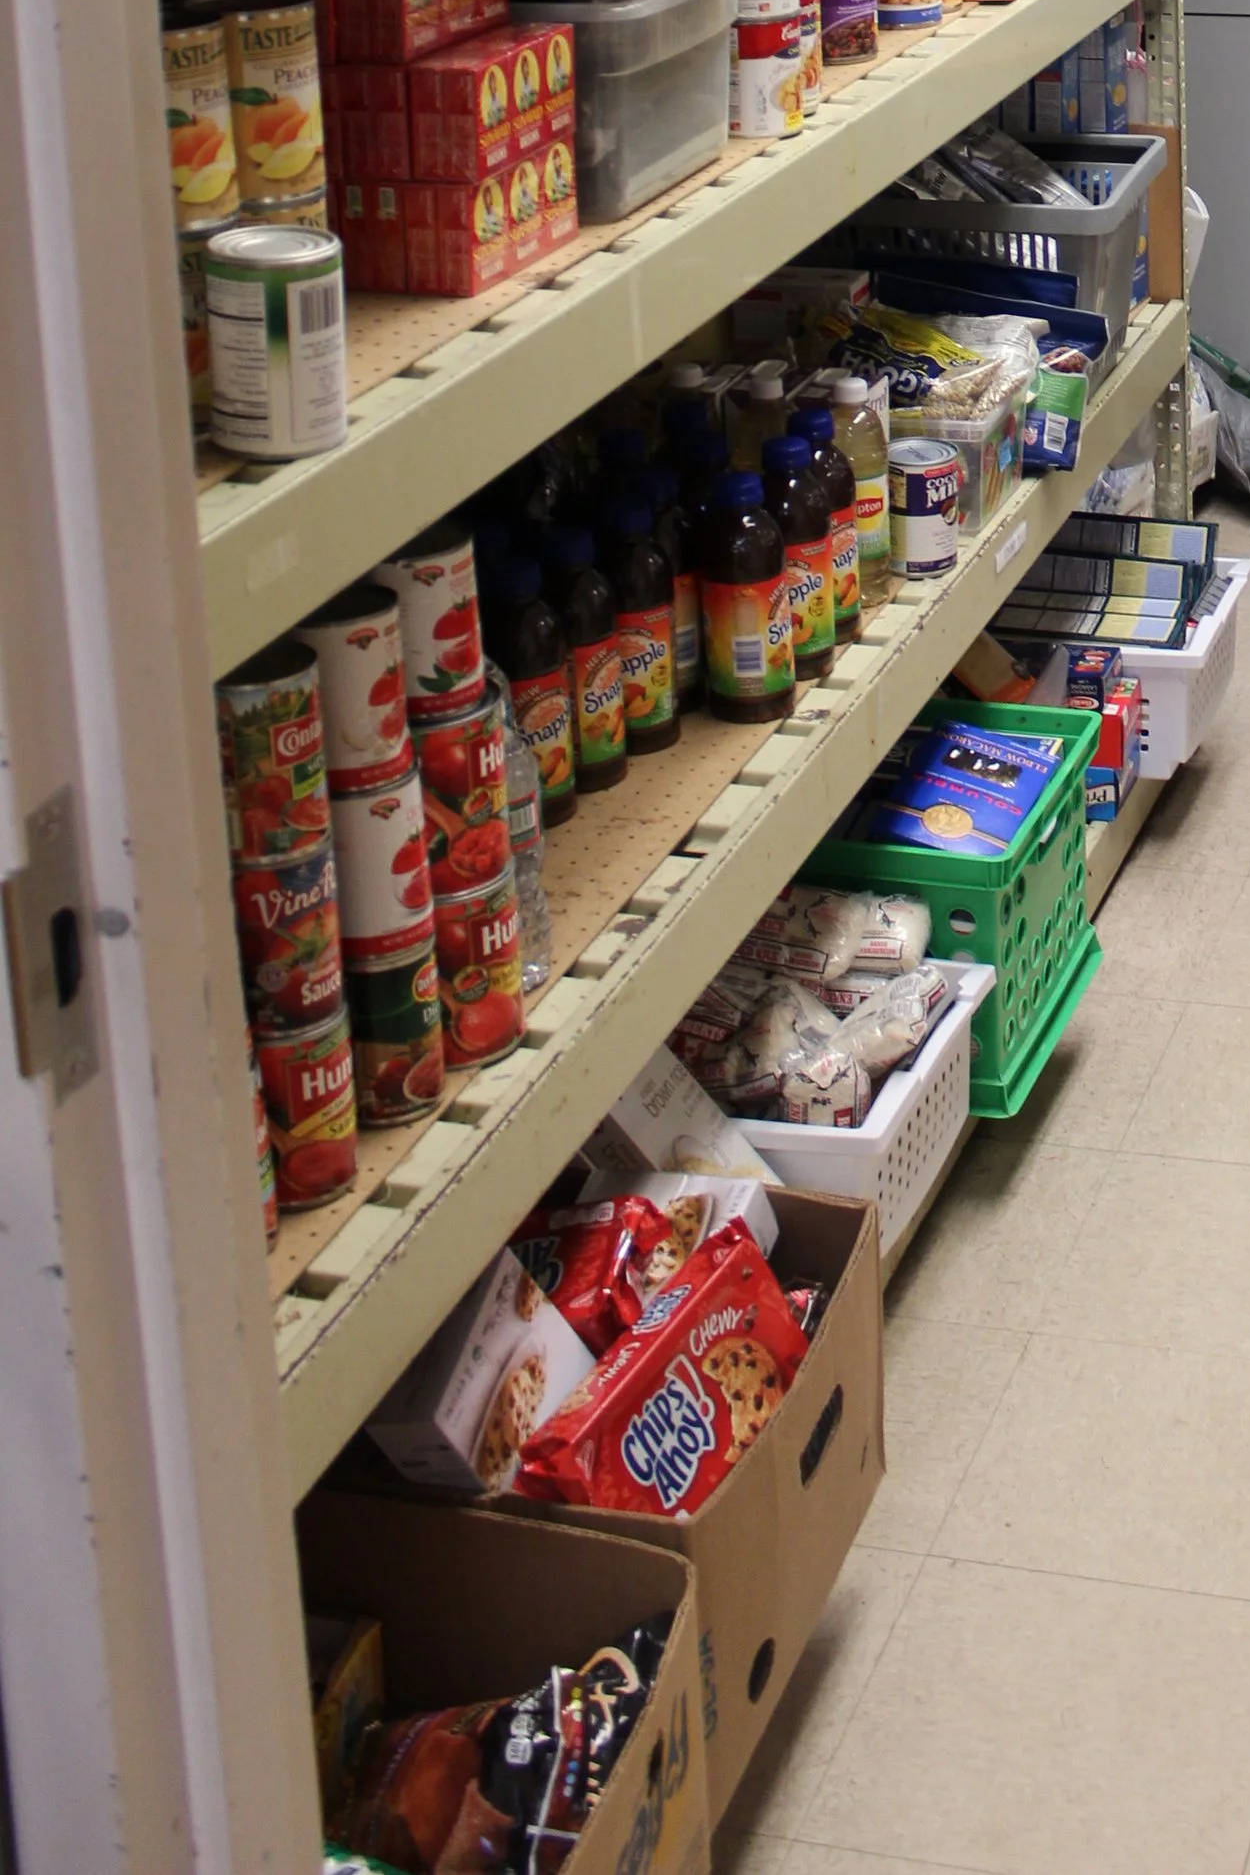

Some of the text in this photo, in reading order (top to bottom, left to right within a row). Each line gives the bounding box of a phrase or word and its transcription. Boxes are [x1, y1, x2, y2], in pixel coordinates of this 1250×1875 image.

[170, 43, 210, 71] ASTE
[238, 24, 293, 52] TASTE
[252, 886, 320, 929] Vine
[641, 1077, 676, 1119] brown
[622, 1377, 687, 1485] Chips
